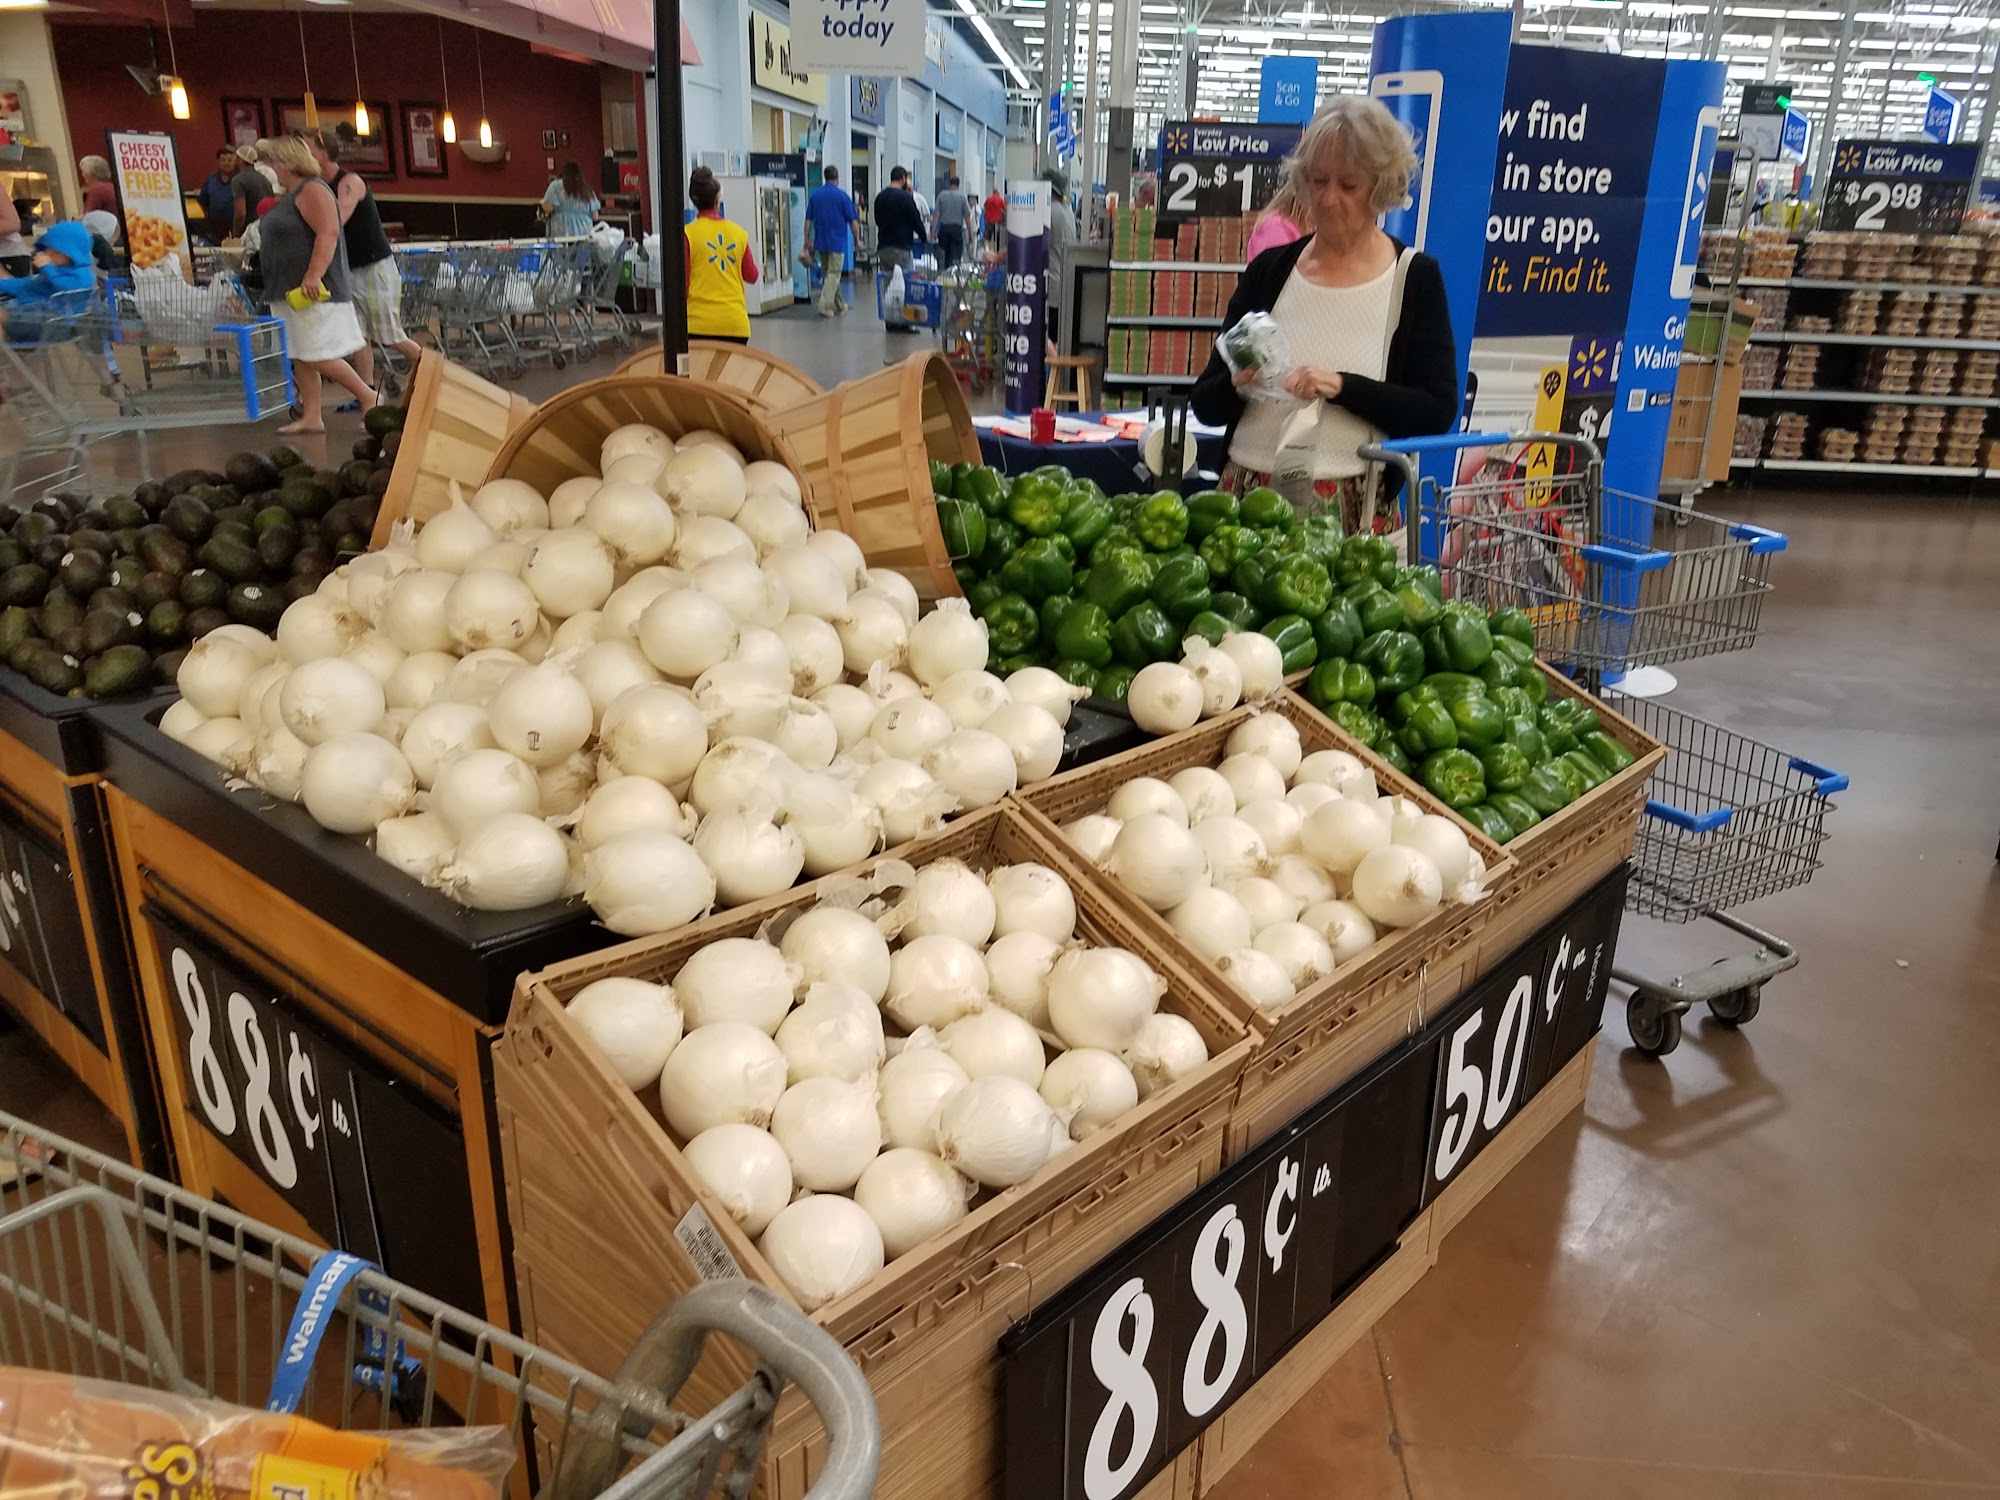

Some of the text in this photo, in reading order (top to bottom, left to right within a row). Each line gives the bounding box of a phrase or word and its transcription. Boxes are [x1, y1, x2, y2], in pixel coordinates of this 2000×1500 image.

[822, 13, 895, 47] today
[1275, 95, 1300, 107] & Go
[1276, 80, 1300, 94] Scan
[1527, 99, 1588, 142] find
[119, 142, 166, 157] CHEESY
[1192, 134, 1269, 154] Low Price
[121, 156, 169, 171] BACON
[1502, 151, 1613, 195] in store
[1863, 153, 1900, 171] Low
[1901, 153, 1944, 174] Price
[124, 171, 174, 191] FRIES
[1166, 162, 1198, 212] 2
[1198, 175, 1212, 189] for
[1485, 215, 1601, 255] our app.
[1486, 256, 1611, 294] it. Find it.
[1531, 444, 1548, 469] A
[1585, 942, 1604, 1002] Mexico
[285, 1252, 360, 1365] Walmart
